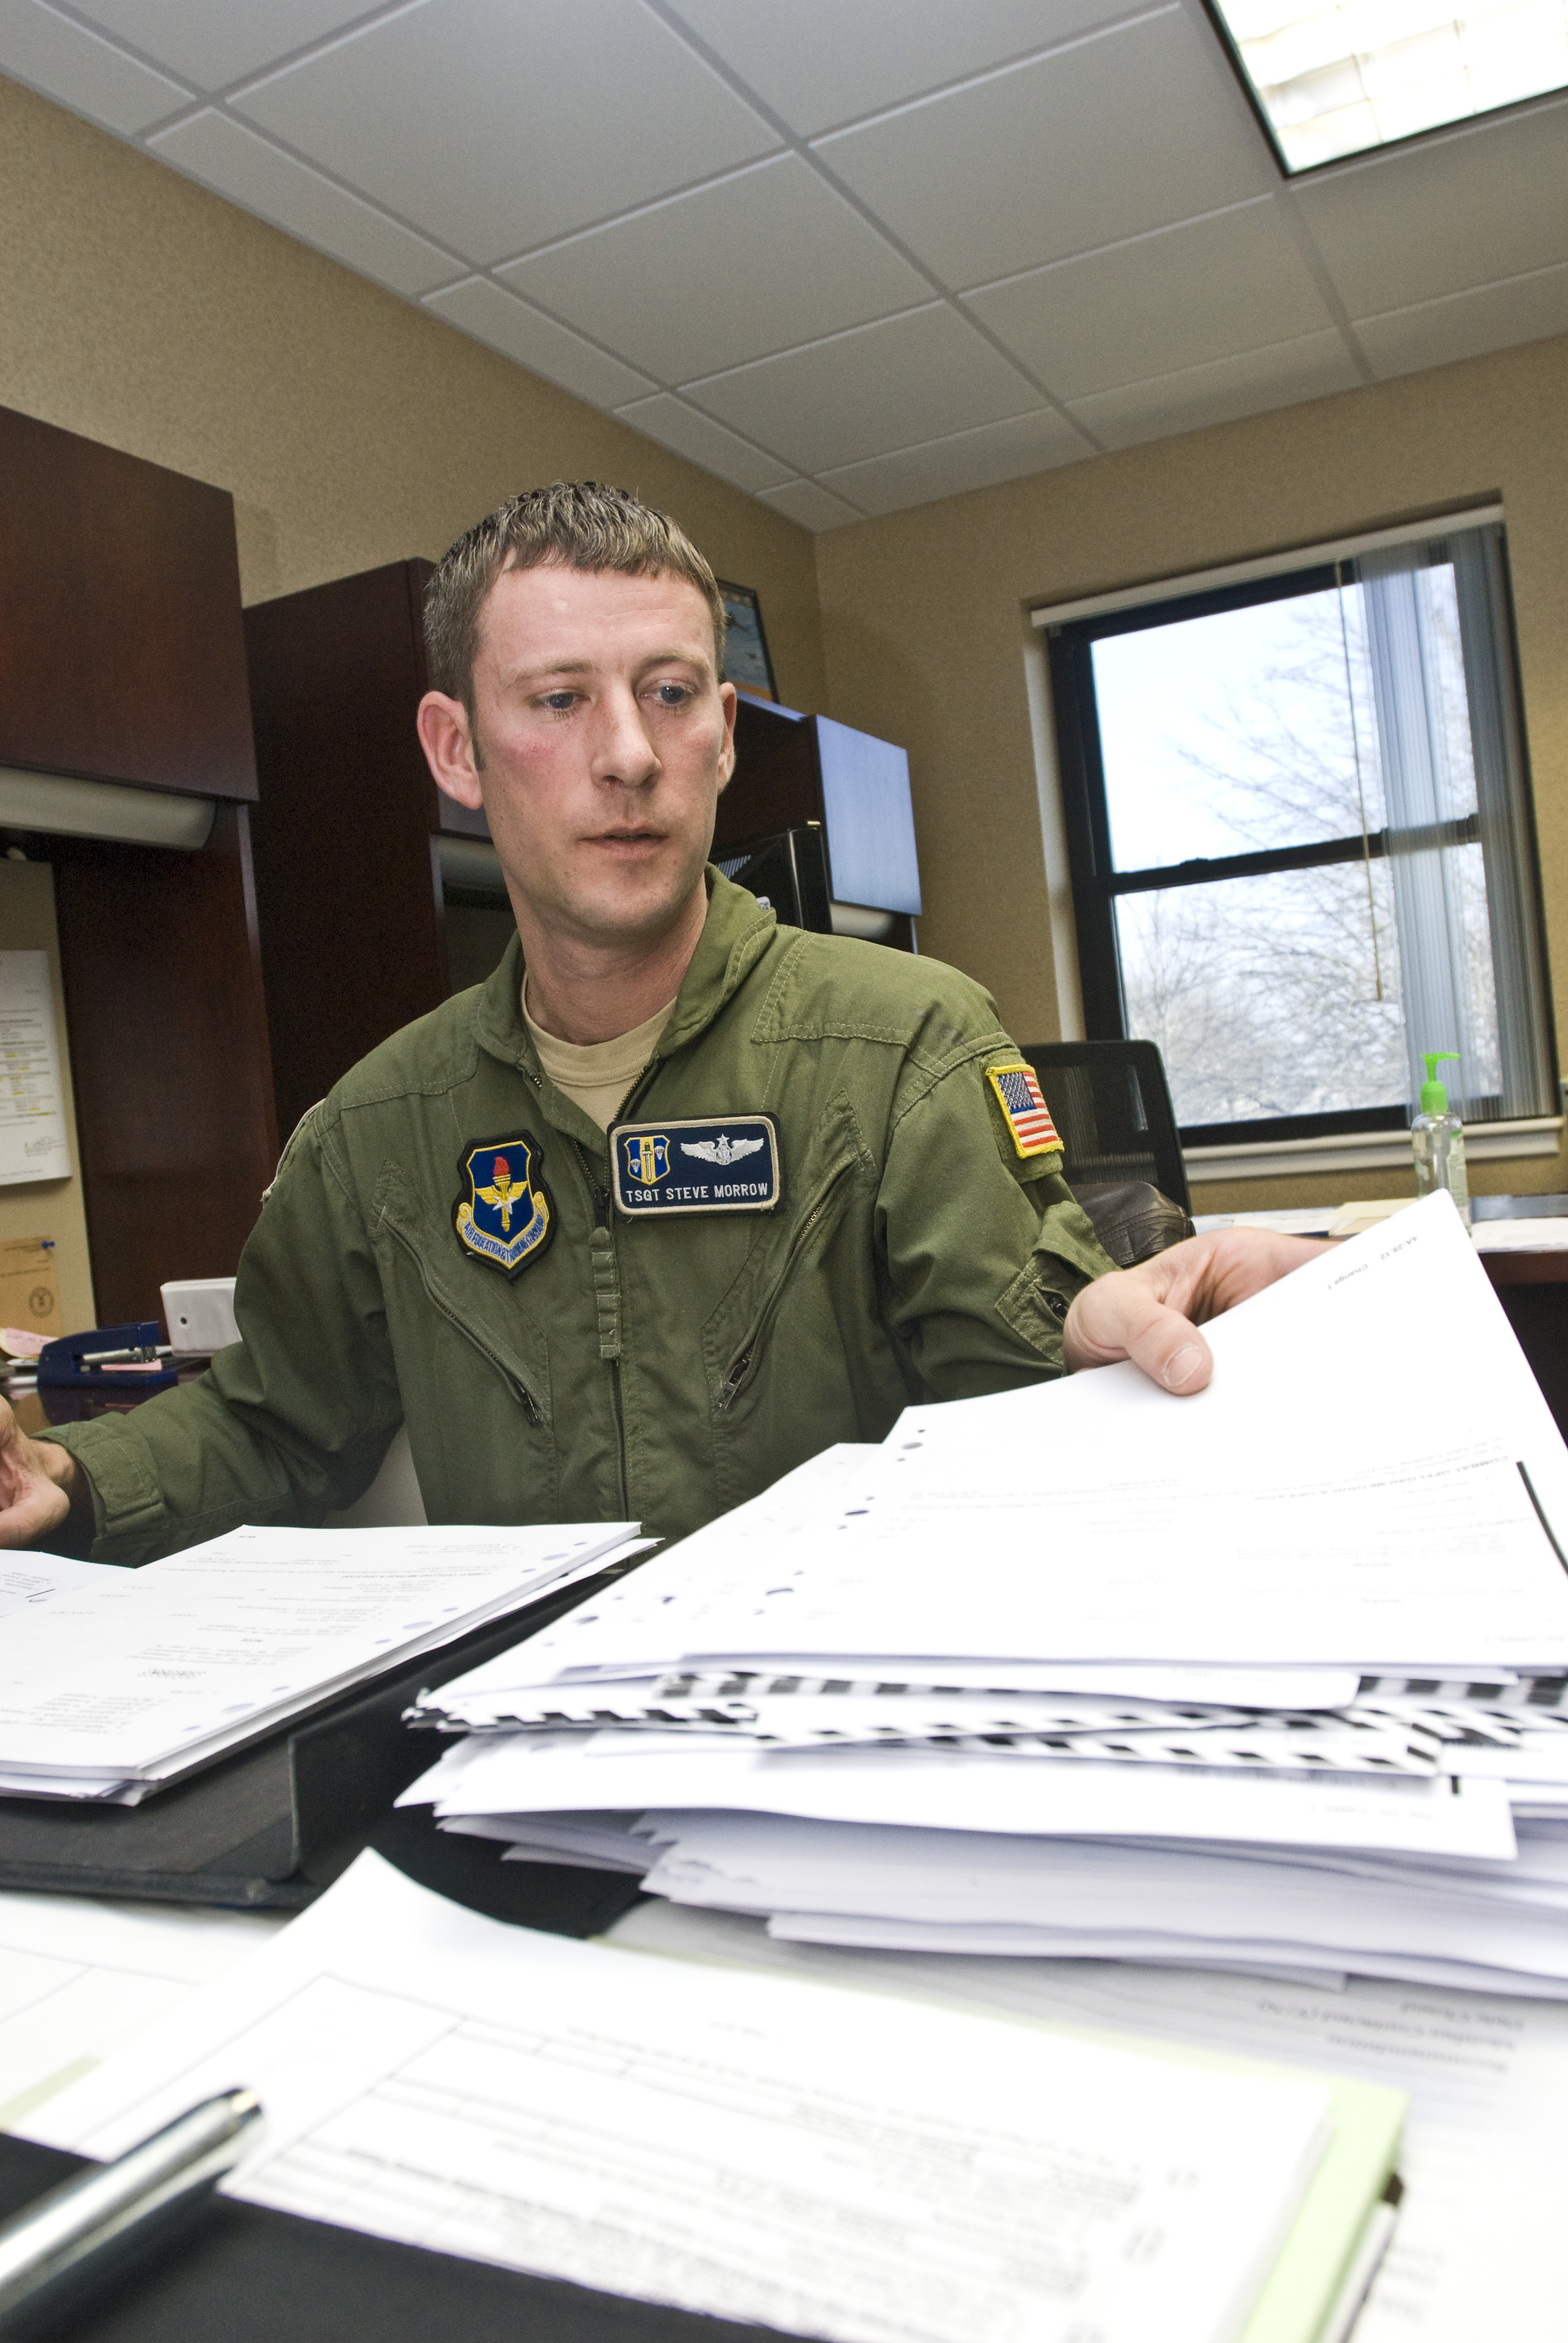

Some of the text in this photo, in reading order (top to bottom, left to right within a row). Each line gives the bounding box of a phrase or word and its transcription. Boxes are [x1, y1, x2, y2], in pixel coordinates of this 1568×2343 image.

[626, 1182, 768, 1202] TSGT STEVE MORROW
[464, 1222, 475, 1240] AIR
[1334, 1264, 1368, 1285] Change
